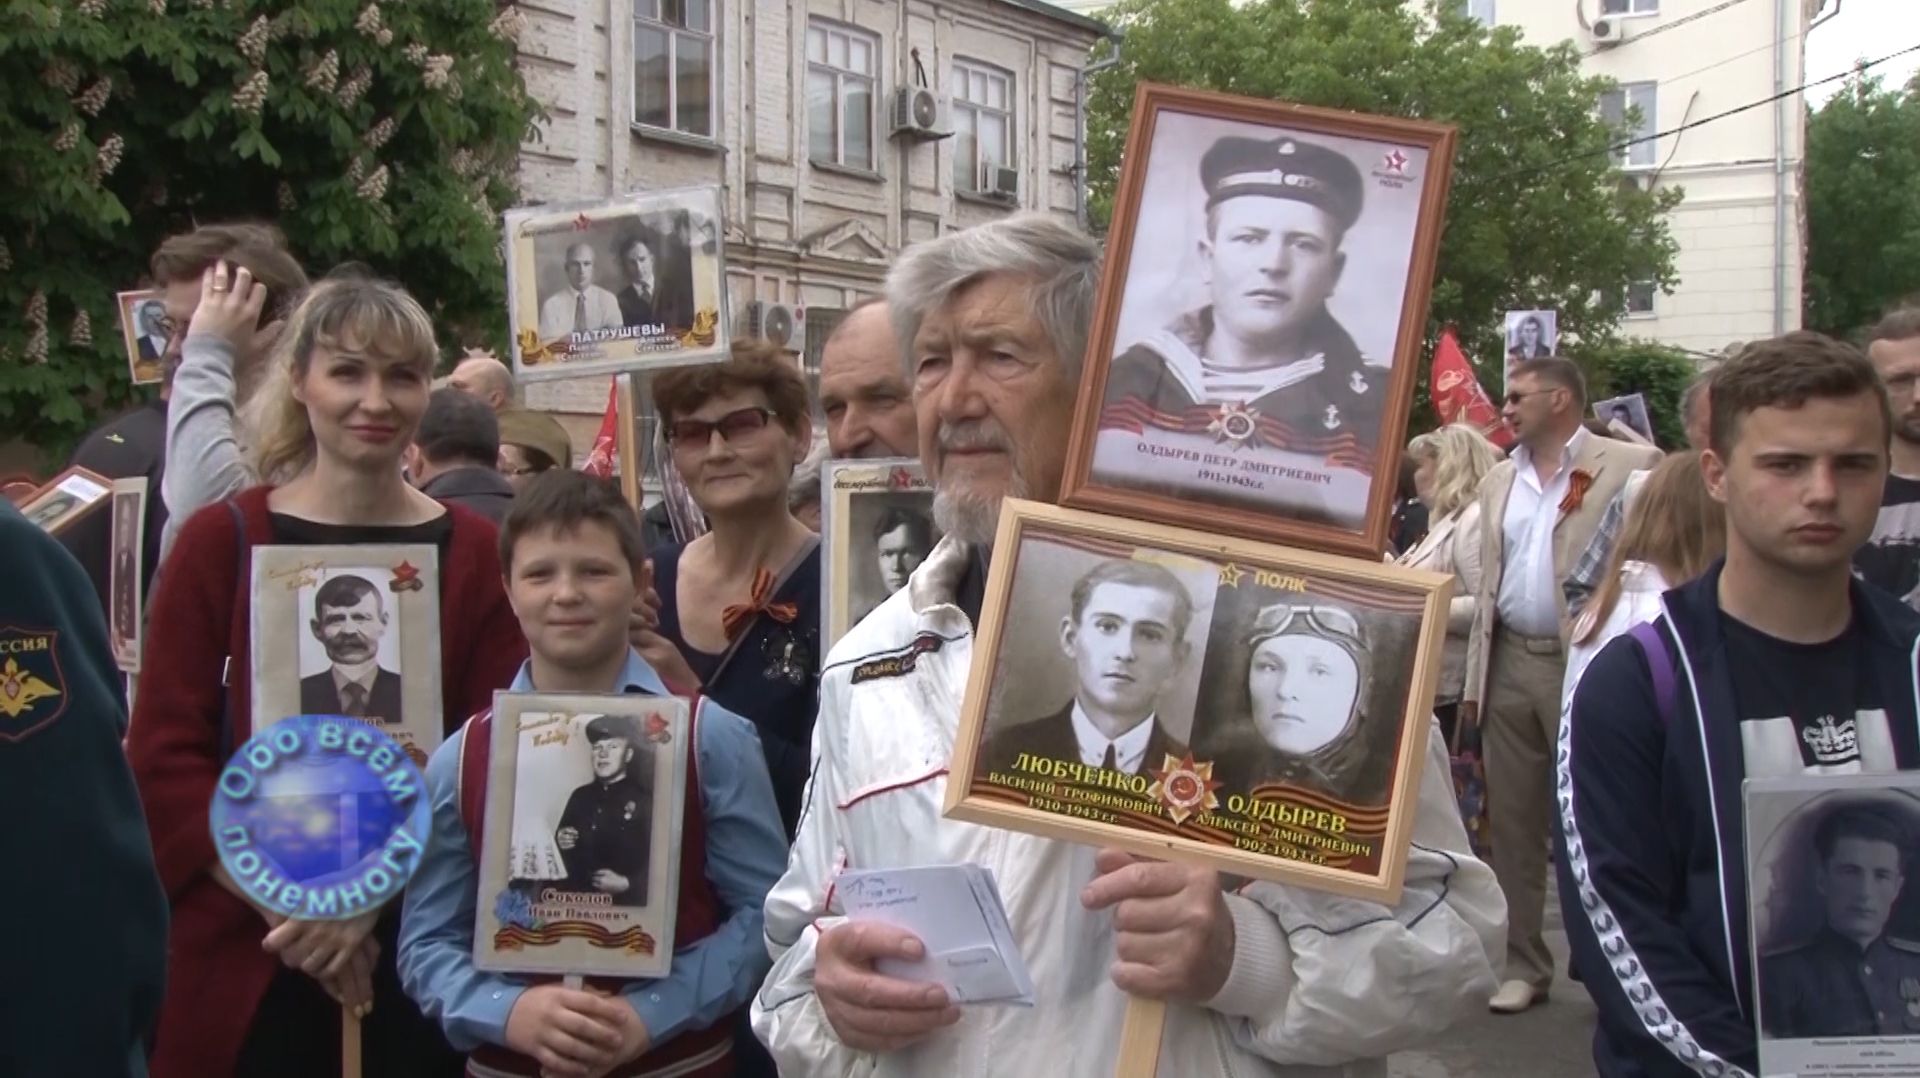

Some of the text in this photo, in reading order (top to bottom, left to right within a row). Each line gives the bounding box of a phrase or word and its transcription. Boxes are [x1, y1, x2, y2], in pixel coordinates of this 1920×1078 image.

[571, 322, 666, 343] ПАТРУШЕВЫ
[1136, 442, 1332, 485] ОЛДЫРЕВ ПЕТР ДМИТРИЕВИЧ
[1254, 570, 1308, 593] ПОЛК
[1011, 752, 1148, 794] ЛЮБЧЕНКО
[989, 772, 1164, 816] ВАСИЛИЙ ТРОФИМОВИЧ
[1027, 796, 1099, 820] 1910-1943
[1227, 795, 1347, 834] ОЛДЫРЕВ
[1195, 813, 1372, 858] АЛЕКСЕЙ ДМИТРИЕВИЧ
[1234, 836, 1307, 861] 1902-1943
